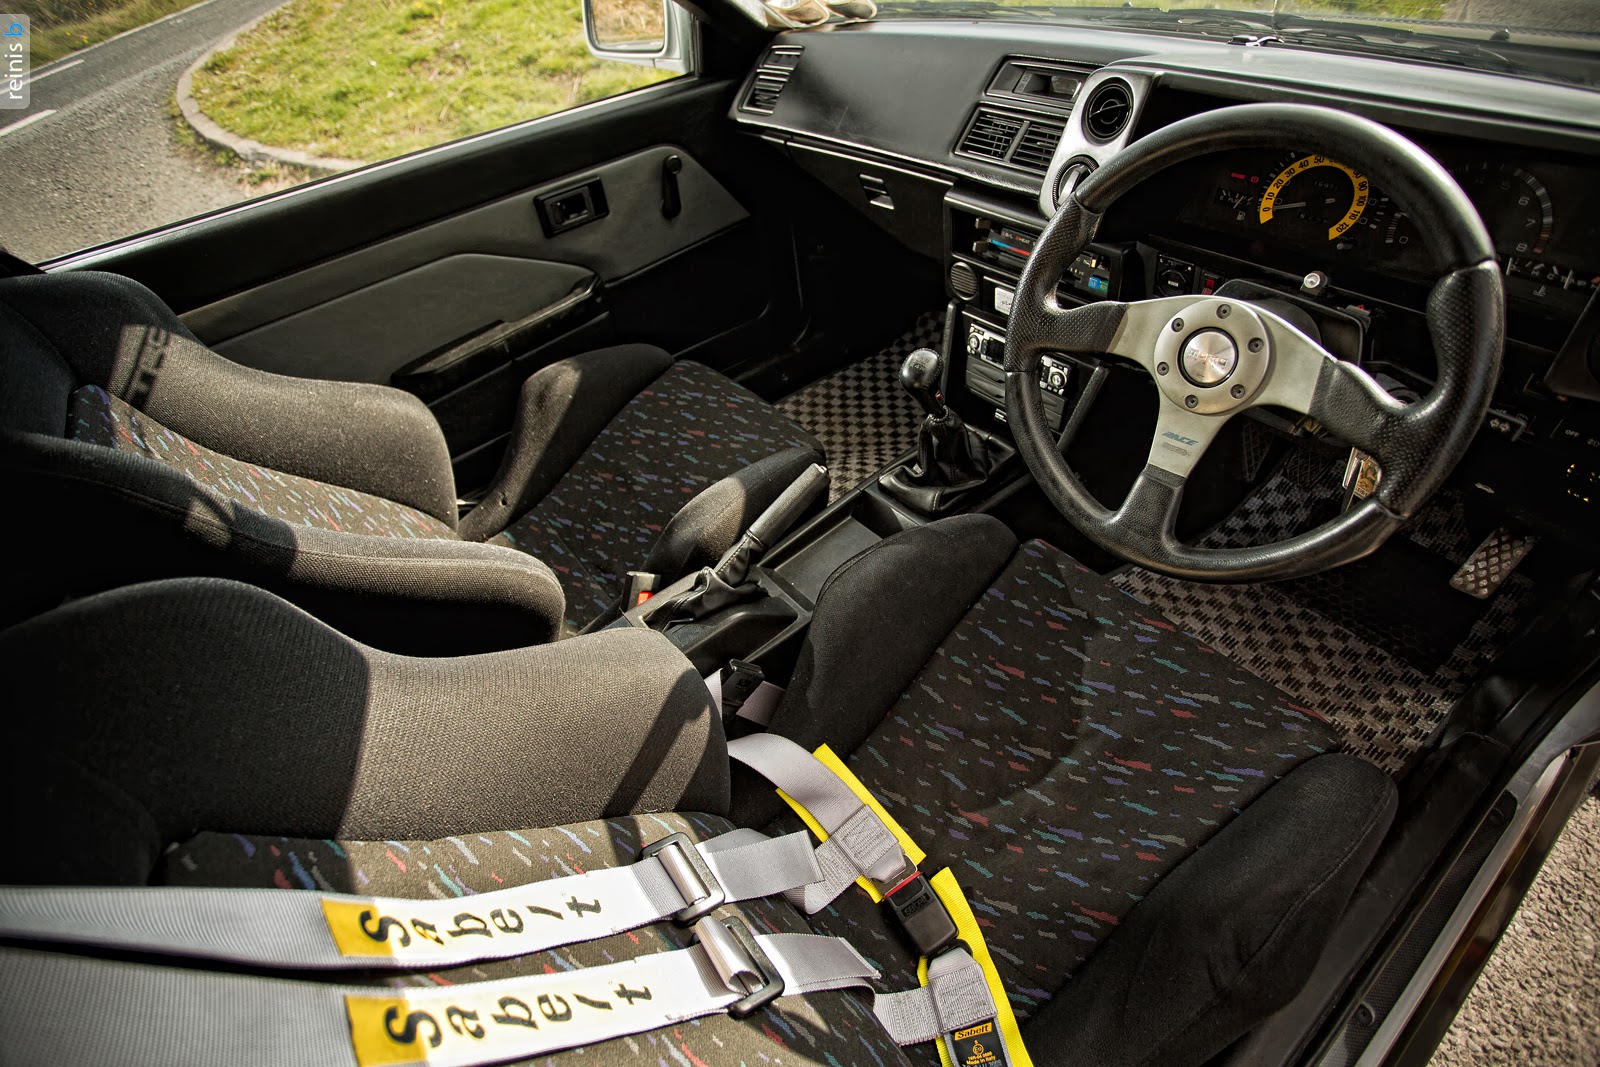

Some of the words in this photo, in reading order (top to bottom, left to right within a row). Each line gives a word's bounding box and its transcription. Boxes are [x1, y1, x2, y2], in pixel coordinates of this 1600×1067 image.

[1314, 155, 1325, 163] 50
[1299, 160, 1309, 169] 40
[1285, 168, 1295, 178] 30
[1273, 179, 1284, 189] 20
[1358, 181, 1367, 191] 90
[1266, 192, 1274, 201] 10
[1356, 195, 1366, 206] 100
[1518, 196, 1530, 206] 6
[1349, 210, 1360, 220] 110
[1336, 222, 1349, 232] 120
[1516, 242, 1528, 252] 8
[1565, 429, 1580, 437] OFF
[359, 896, 601, 947] Sabelt
[385, 983, 652, 1048] Sabelt
[958, 1025, 989, 1038] Sabelt
